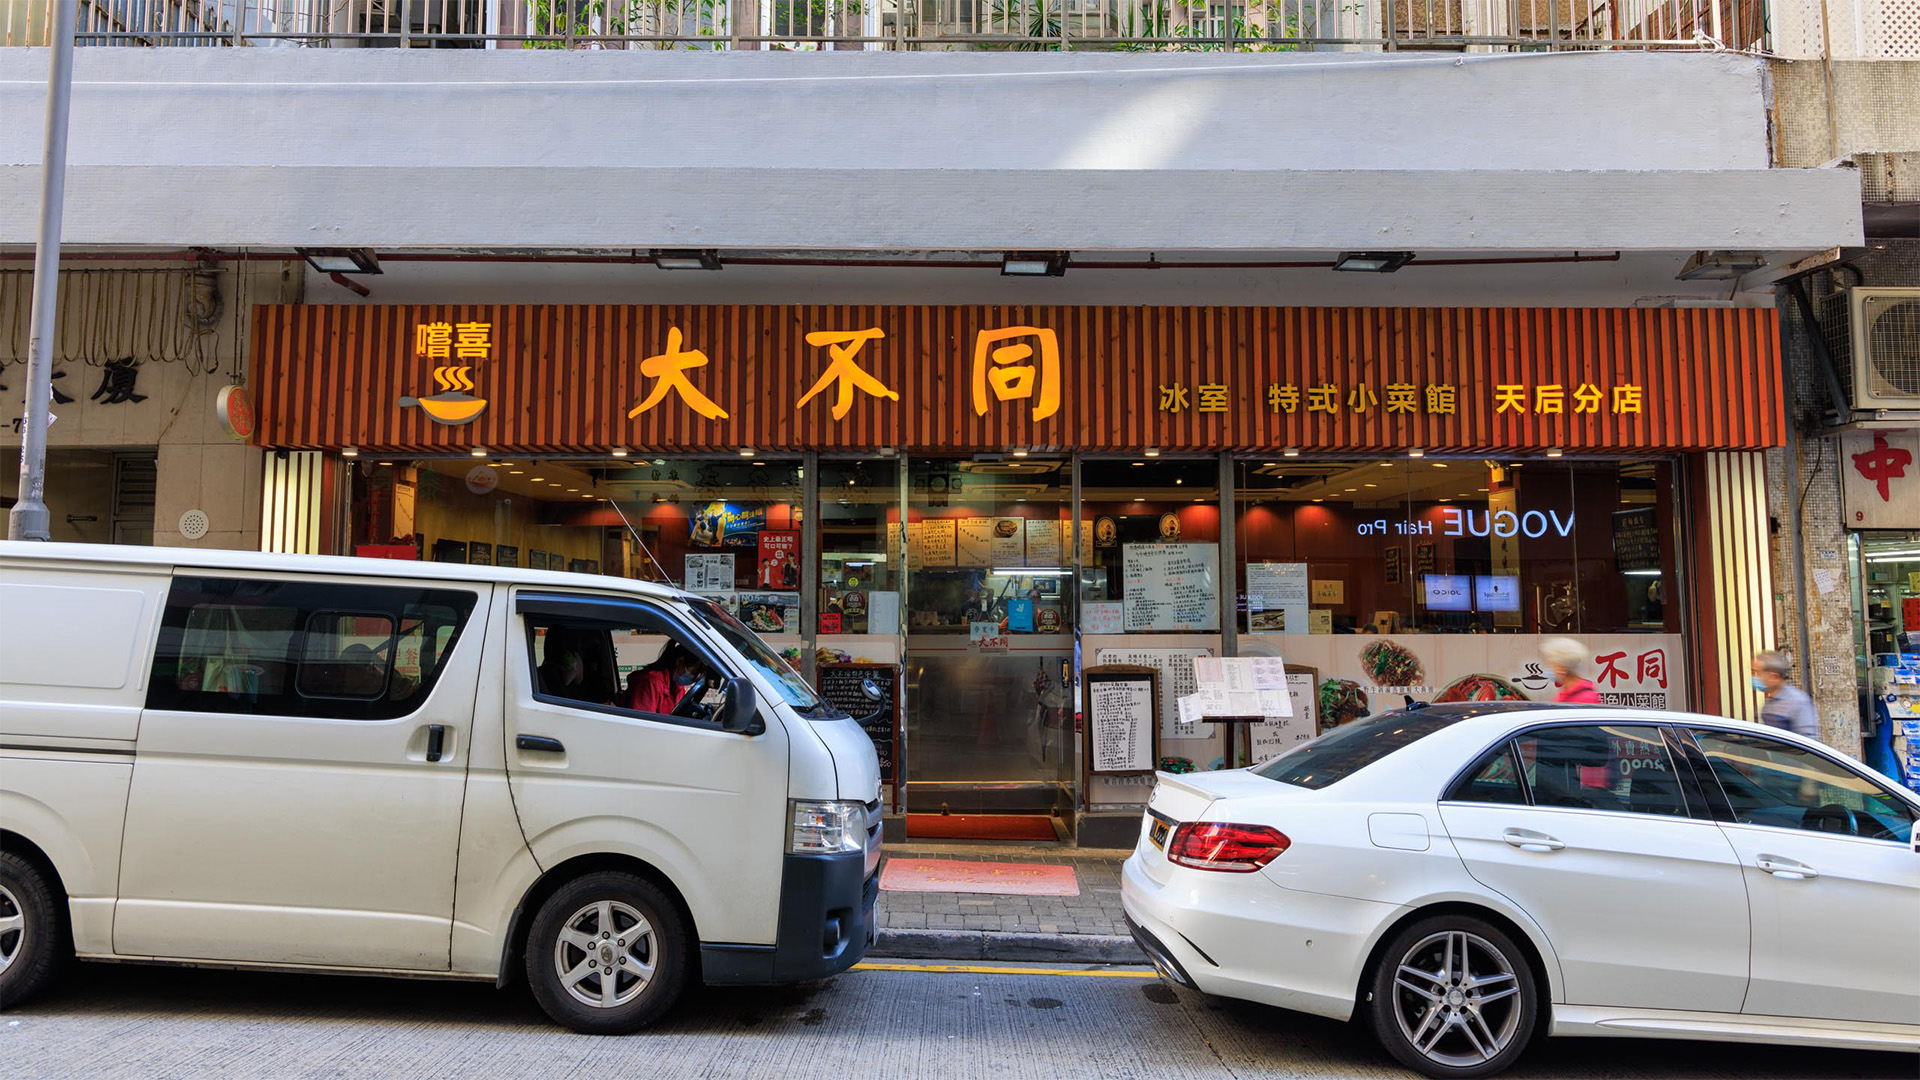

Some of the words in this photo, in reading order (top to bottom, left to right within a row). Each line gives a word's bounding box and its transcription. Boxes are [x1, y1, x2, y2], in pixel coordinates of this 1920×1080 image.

[416, 321, 492, 360] 嘗喜
[627, 326, 1061, 423] 大不同
[1159, 382, 1229, 414] 冰室
[1269, 382, 1456, 414] 特式小菜館
[1495, 382, 1643, 415] 天后分店
[1852, 430, 1913, 502] 中
[978, 635, 1009, 648] 大不同
[1595, 648, 1668, 689] 不同
